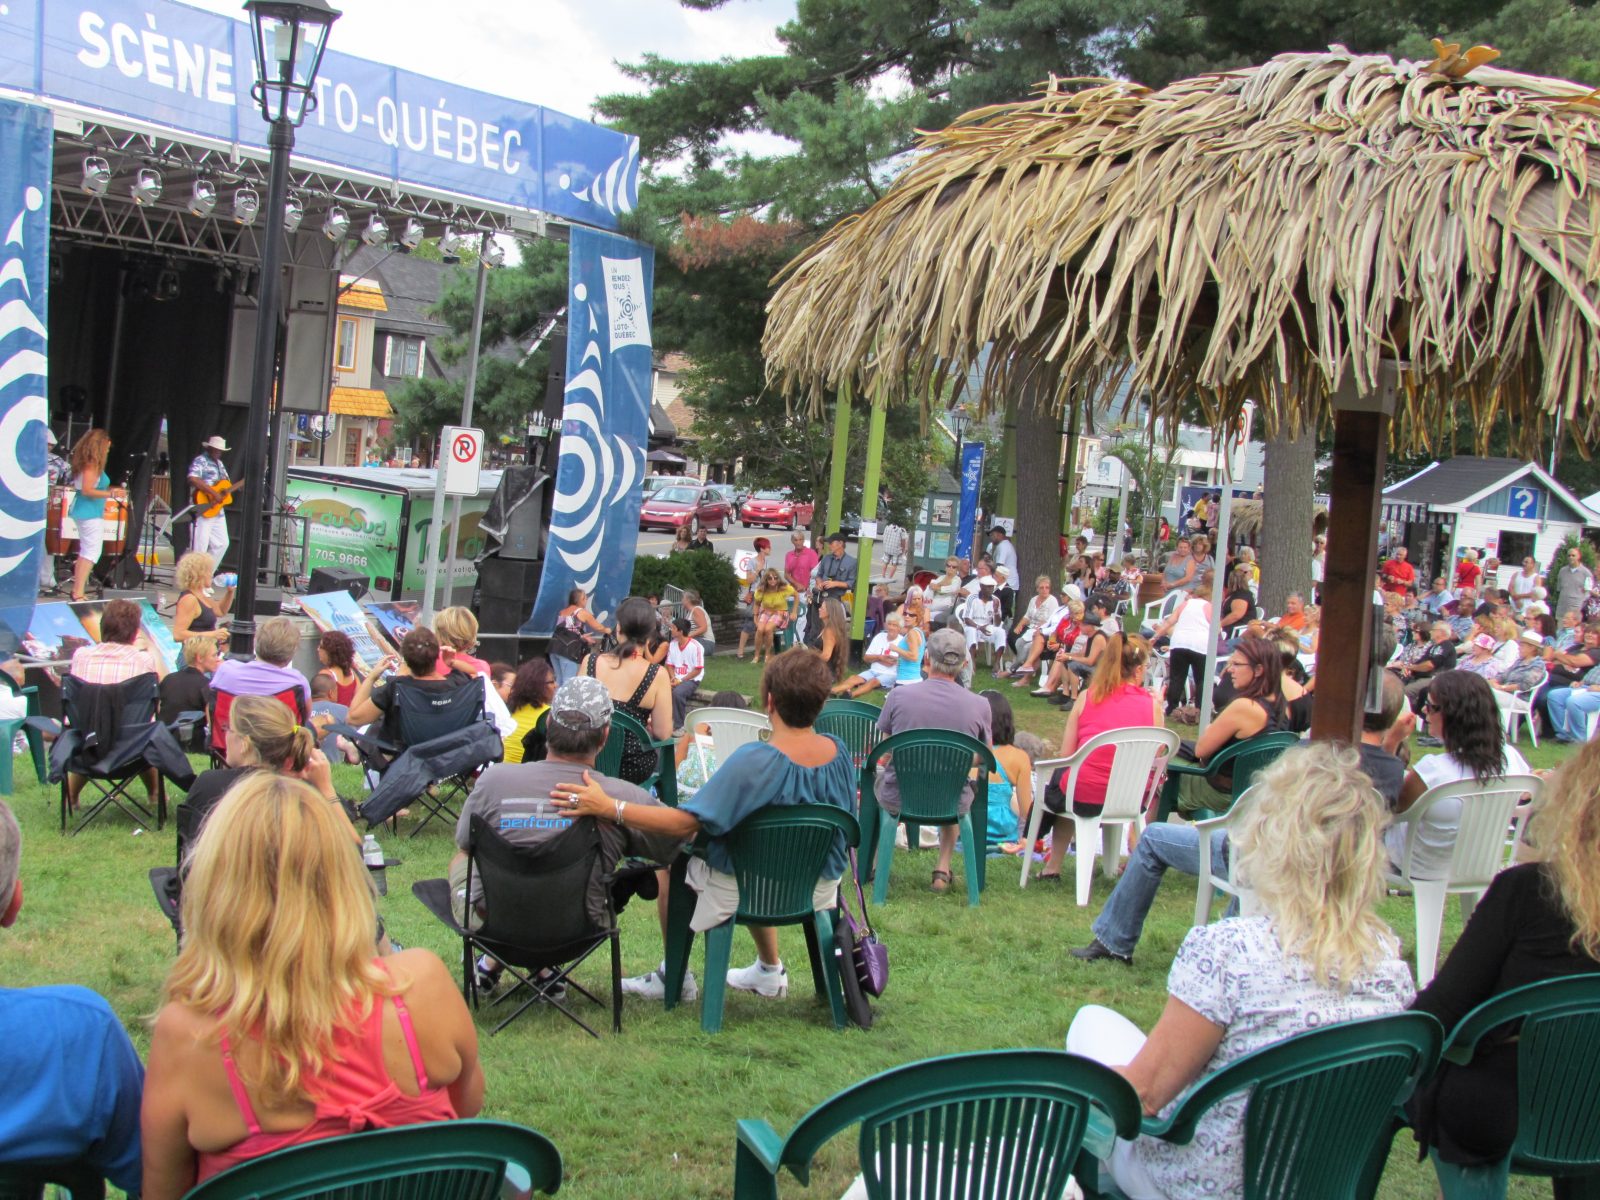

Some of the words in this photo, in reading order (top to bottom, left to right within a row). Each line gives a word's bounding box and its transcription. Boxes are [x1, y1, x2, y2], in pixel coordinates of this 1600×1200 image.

[76, 11, 236, 105] SCÈNE
[320, 511, 345, 528] du
[349, 507, 386, 536] Sud
[500, 816, 572, 830] perform
